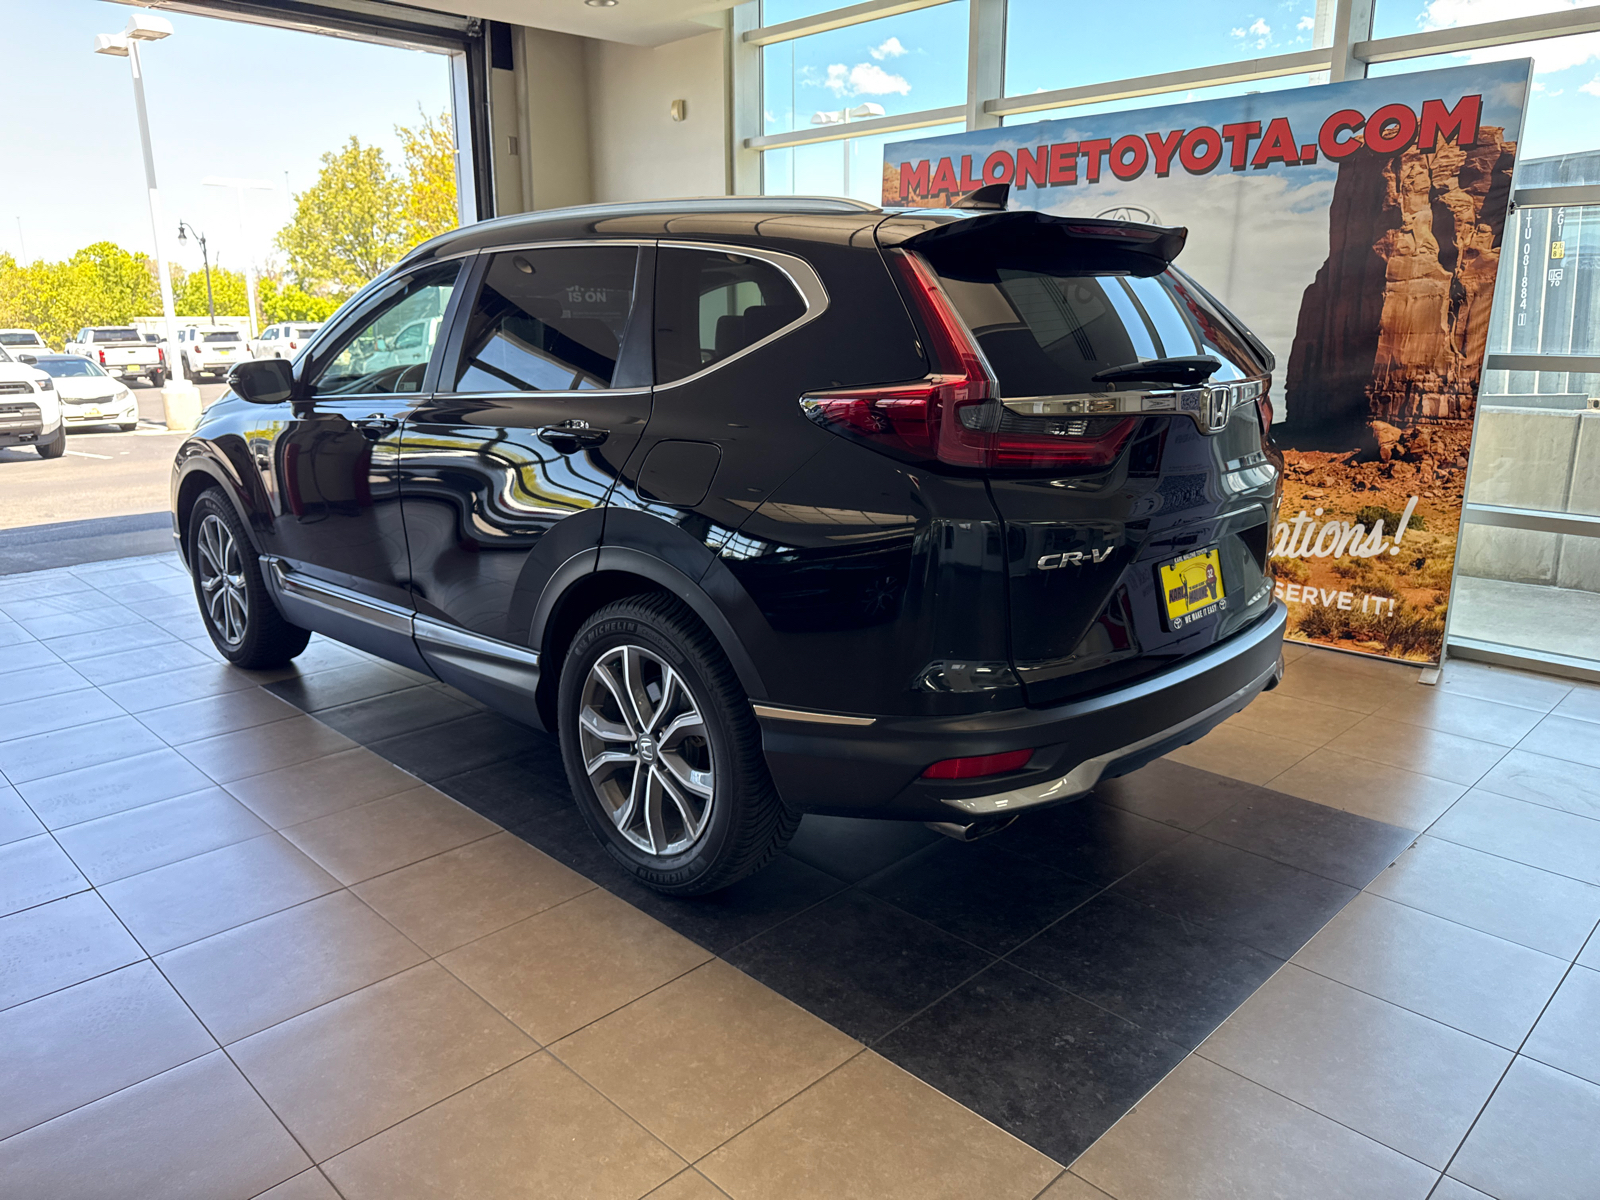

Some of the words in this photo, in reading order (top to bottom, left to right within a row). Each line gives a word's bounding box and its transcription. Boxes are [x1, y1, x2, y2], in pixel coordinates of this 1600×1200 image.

[900, 94, 1483, 200] MALONETOYOTA.COM
[568, 292, 582, 303] IS
[585, 291, 607, 303] ON
[1037, 545, 1115, 571] CR-V
[1184, 614, 1192, 624] WE
[1191, 609, 1203, 622] MAKE
[1207, 603, 1217, 615] EASY
[1361, 594, 1396, 618] IT!
[588, 621, 637, 642] MICHELIN
